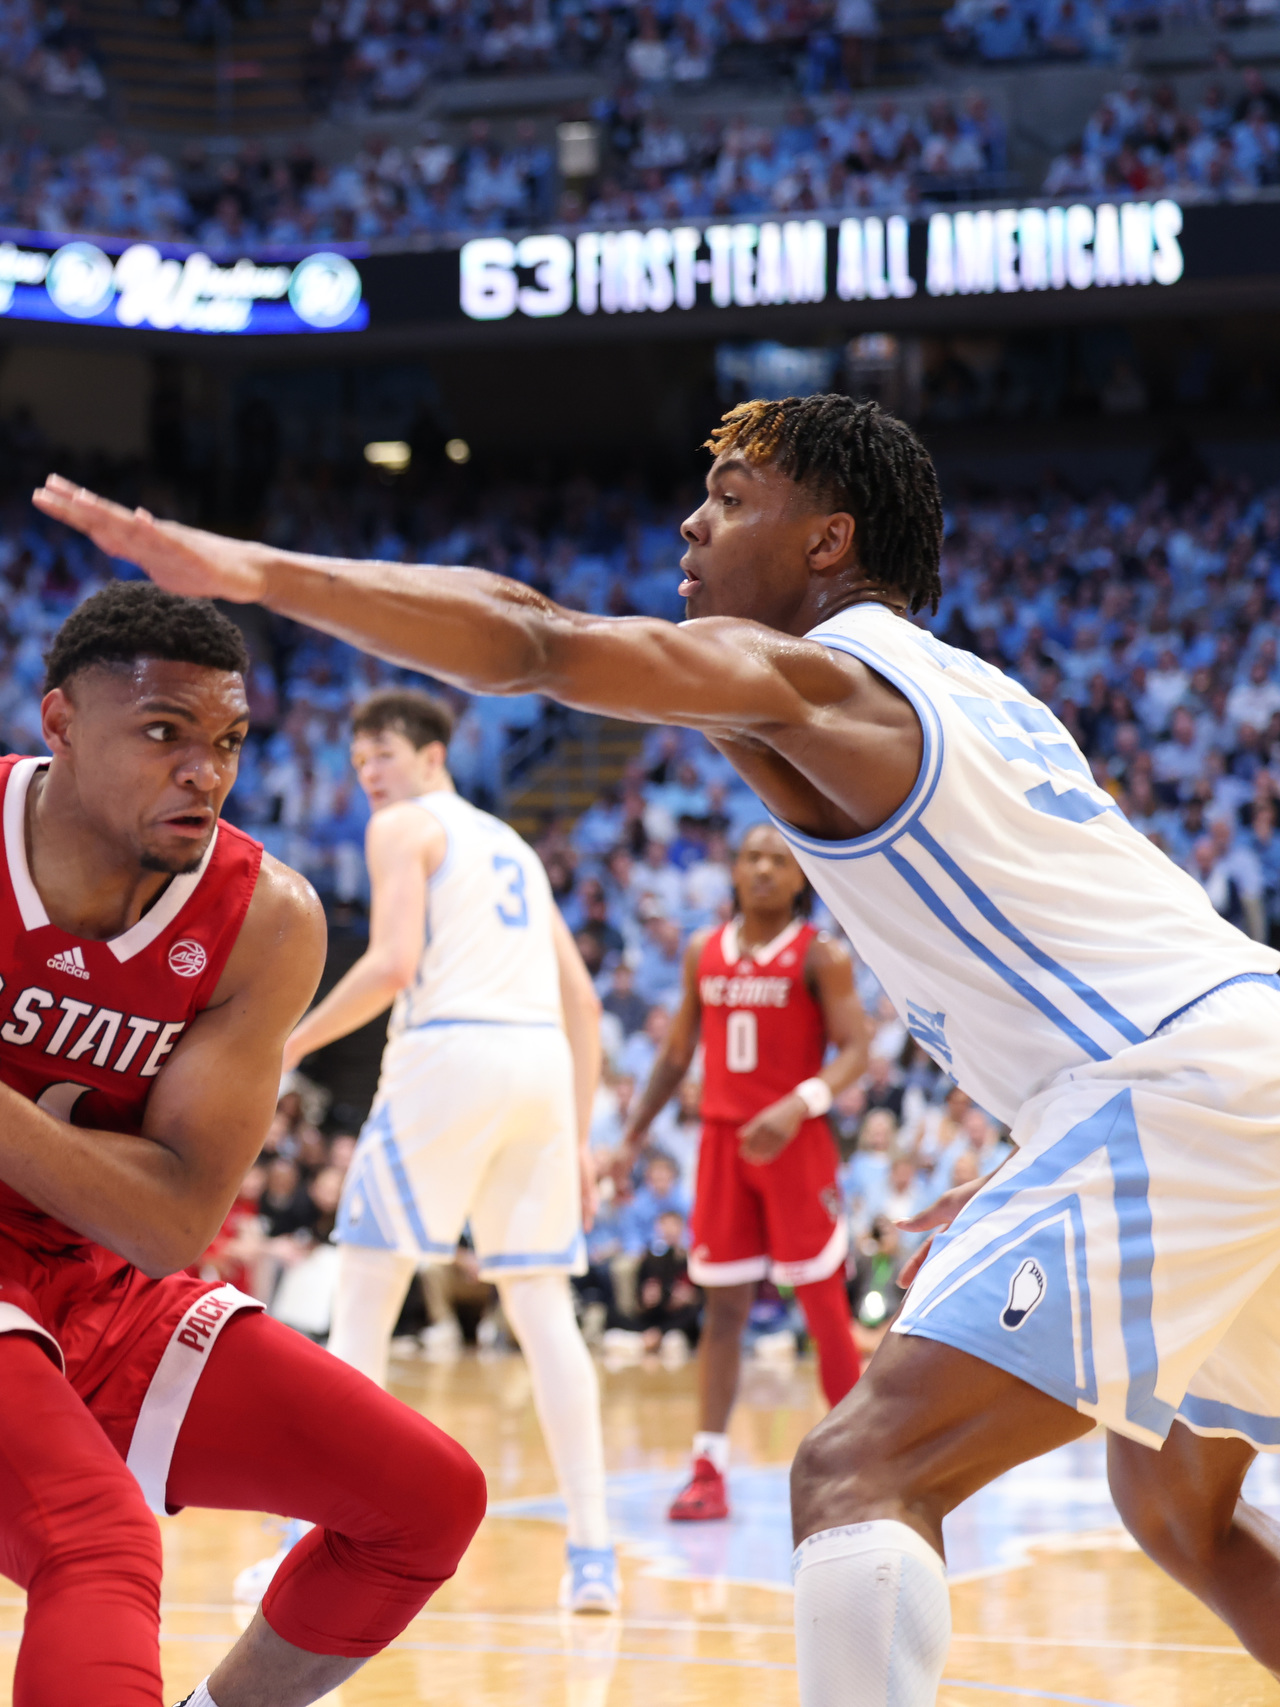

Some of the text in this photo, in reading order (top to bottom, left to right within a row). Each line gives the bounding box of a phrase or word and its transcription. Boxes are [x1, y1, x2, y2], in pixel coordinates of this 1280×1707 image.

[460, 199, 1184, 320] 63 FIRST-TEAM ALL AMERICANS
[491, 855, 529, 929] 3
[46, 957, 91, 981] adidas
[0, 985, 187, 1078] STATE
[725, 1009, 759, 1074] 0
[177, 1295, 235, 1354] PACK
